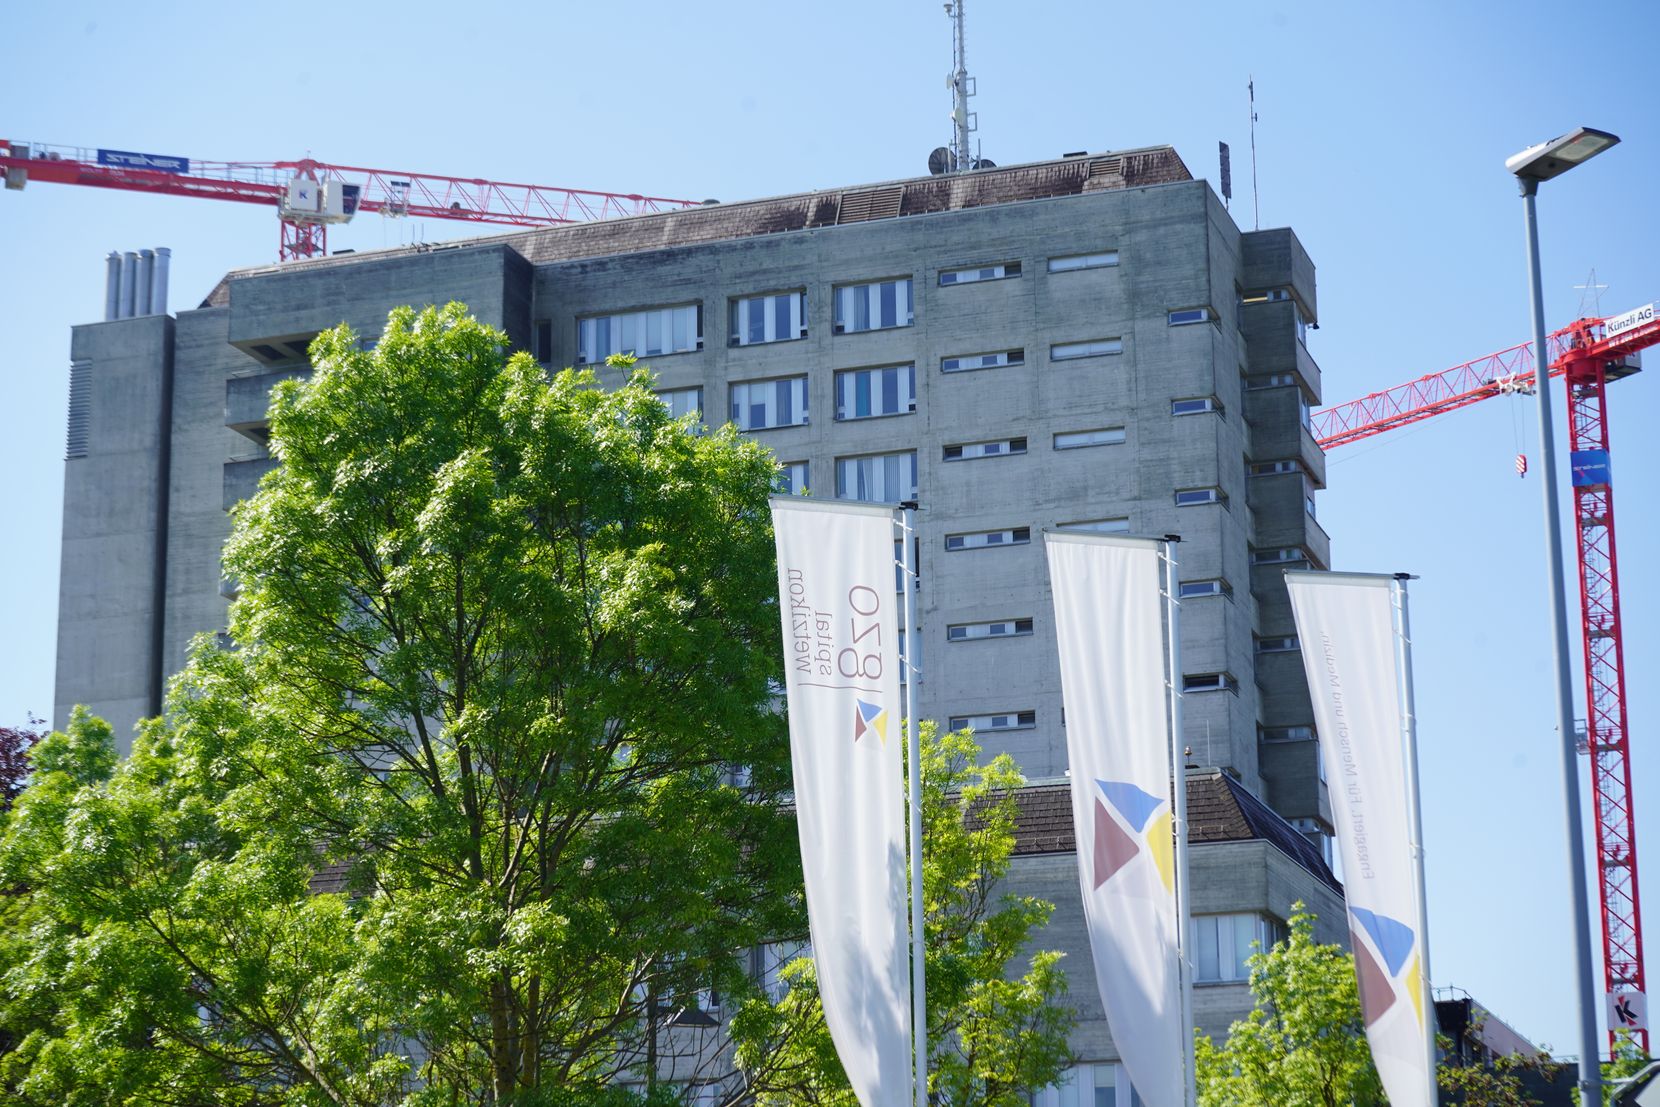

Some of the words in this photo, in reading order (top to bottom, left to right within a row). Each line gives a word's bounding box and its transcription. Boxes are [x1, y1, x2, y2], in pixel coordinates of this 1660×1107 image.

[105, 153, 180, 169] STEINER
[1607, 313, 1636, 333] Künzli
[1637, 308, 1652, 322] AG
